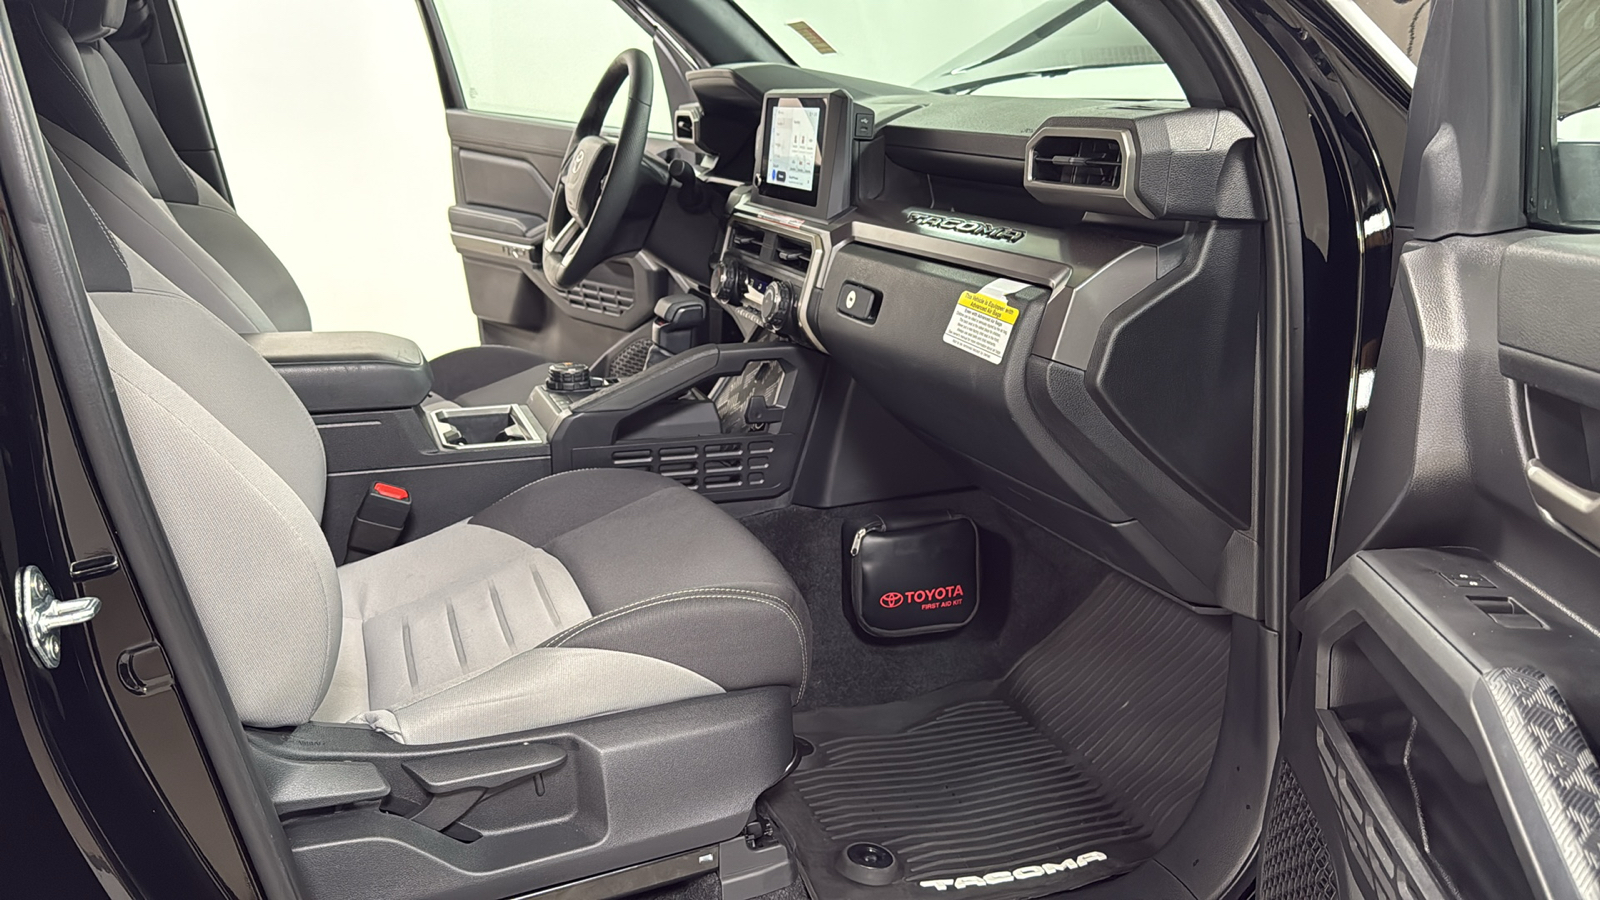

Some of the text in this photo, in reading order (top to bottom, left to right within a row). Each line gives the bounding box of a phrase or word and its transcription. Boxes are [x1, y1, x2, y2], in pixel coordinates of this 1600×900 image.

[907, 211, 1026, 243] TACOMA
[905, 585, 964, 604] TOYOTA
[921, 602, 940, 610] FIRST
[920, 851, 1107, 891] TACOMA
